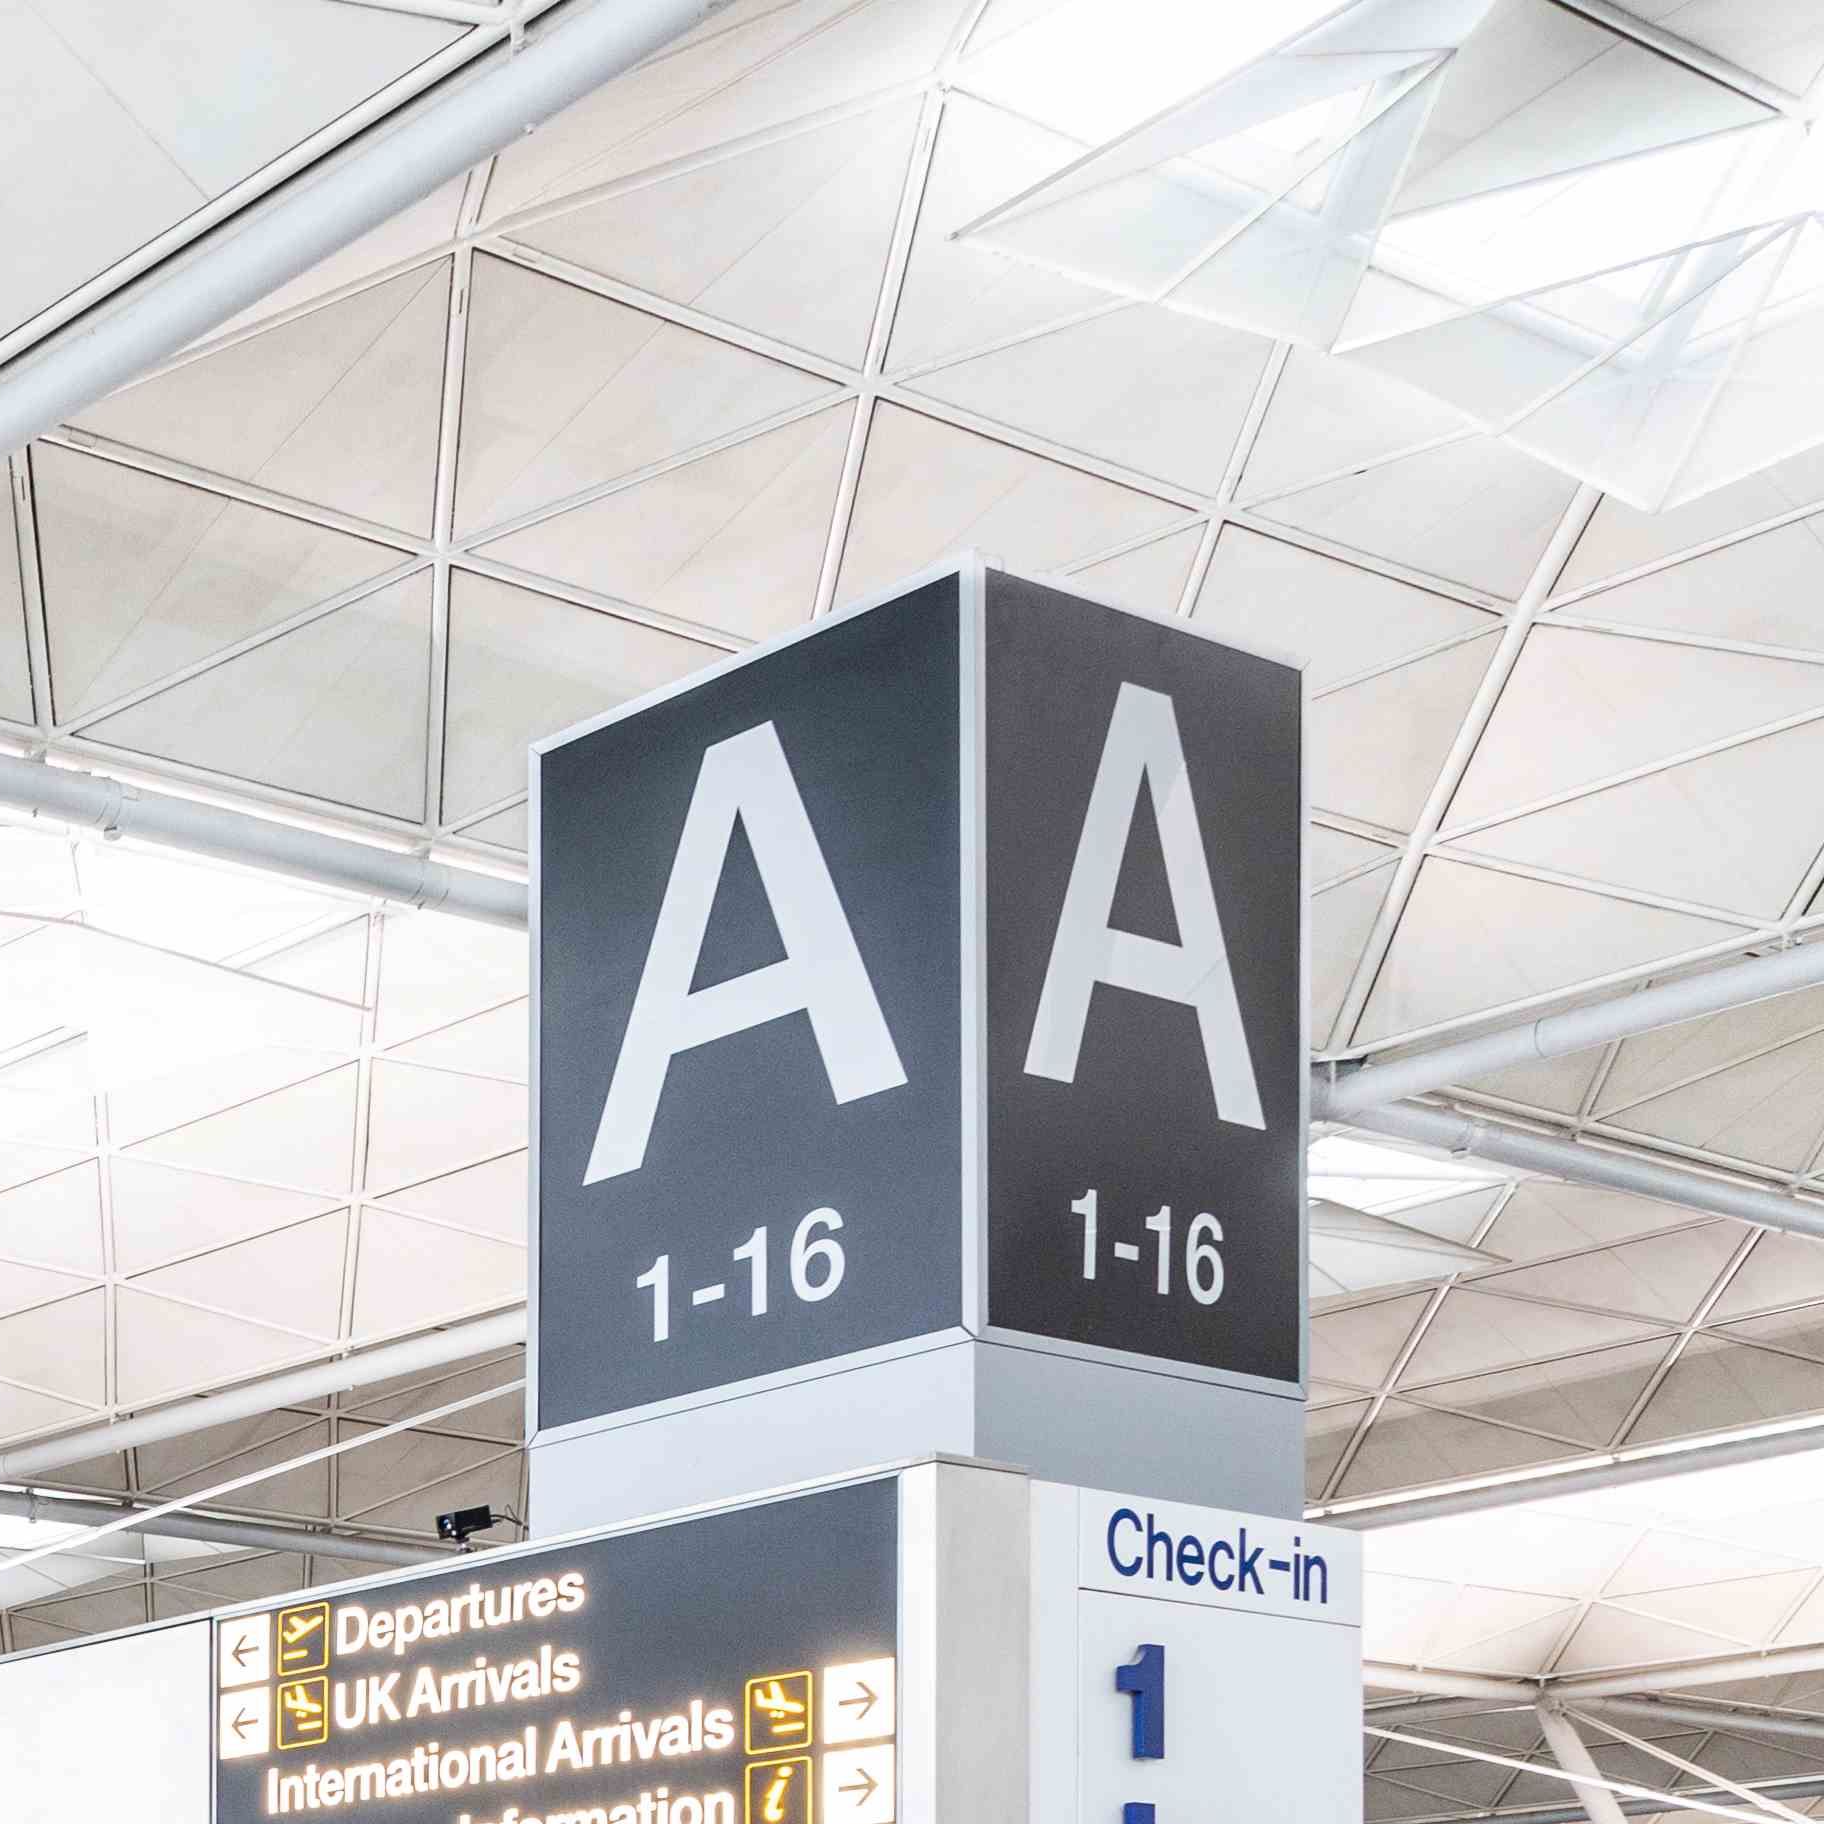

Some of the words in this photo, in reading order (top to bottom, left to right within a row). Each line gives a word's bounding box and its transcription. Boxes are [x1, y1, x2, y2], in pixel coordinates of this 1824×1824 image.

[582, 720, 909, 1188] A
[1023, 681, 1266, 1131] A
[636, 1206, 846, 1343] 1-16
[1070, 1188, 1226, 1306] 1-16
[1105, 1507, 1329, 1604] Check-in
[335, 1570, 586, 1660] Departures
[334, 1676, 401, 1731] UK
[407, 1645, 581, 1718] Arrivals
[1115, 1643, 1167, 1762] 1
[267, 1725, 535, 1815] International
[552, 1699, 736, 1771] Arrivals
